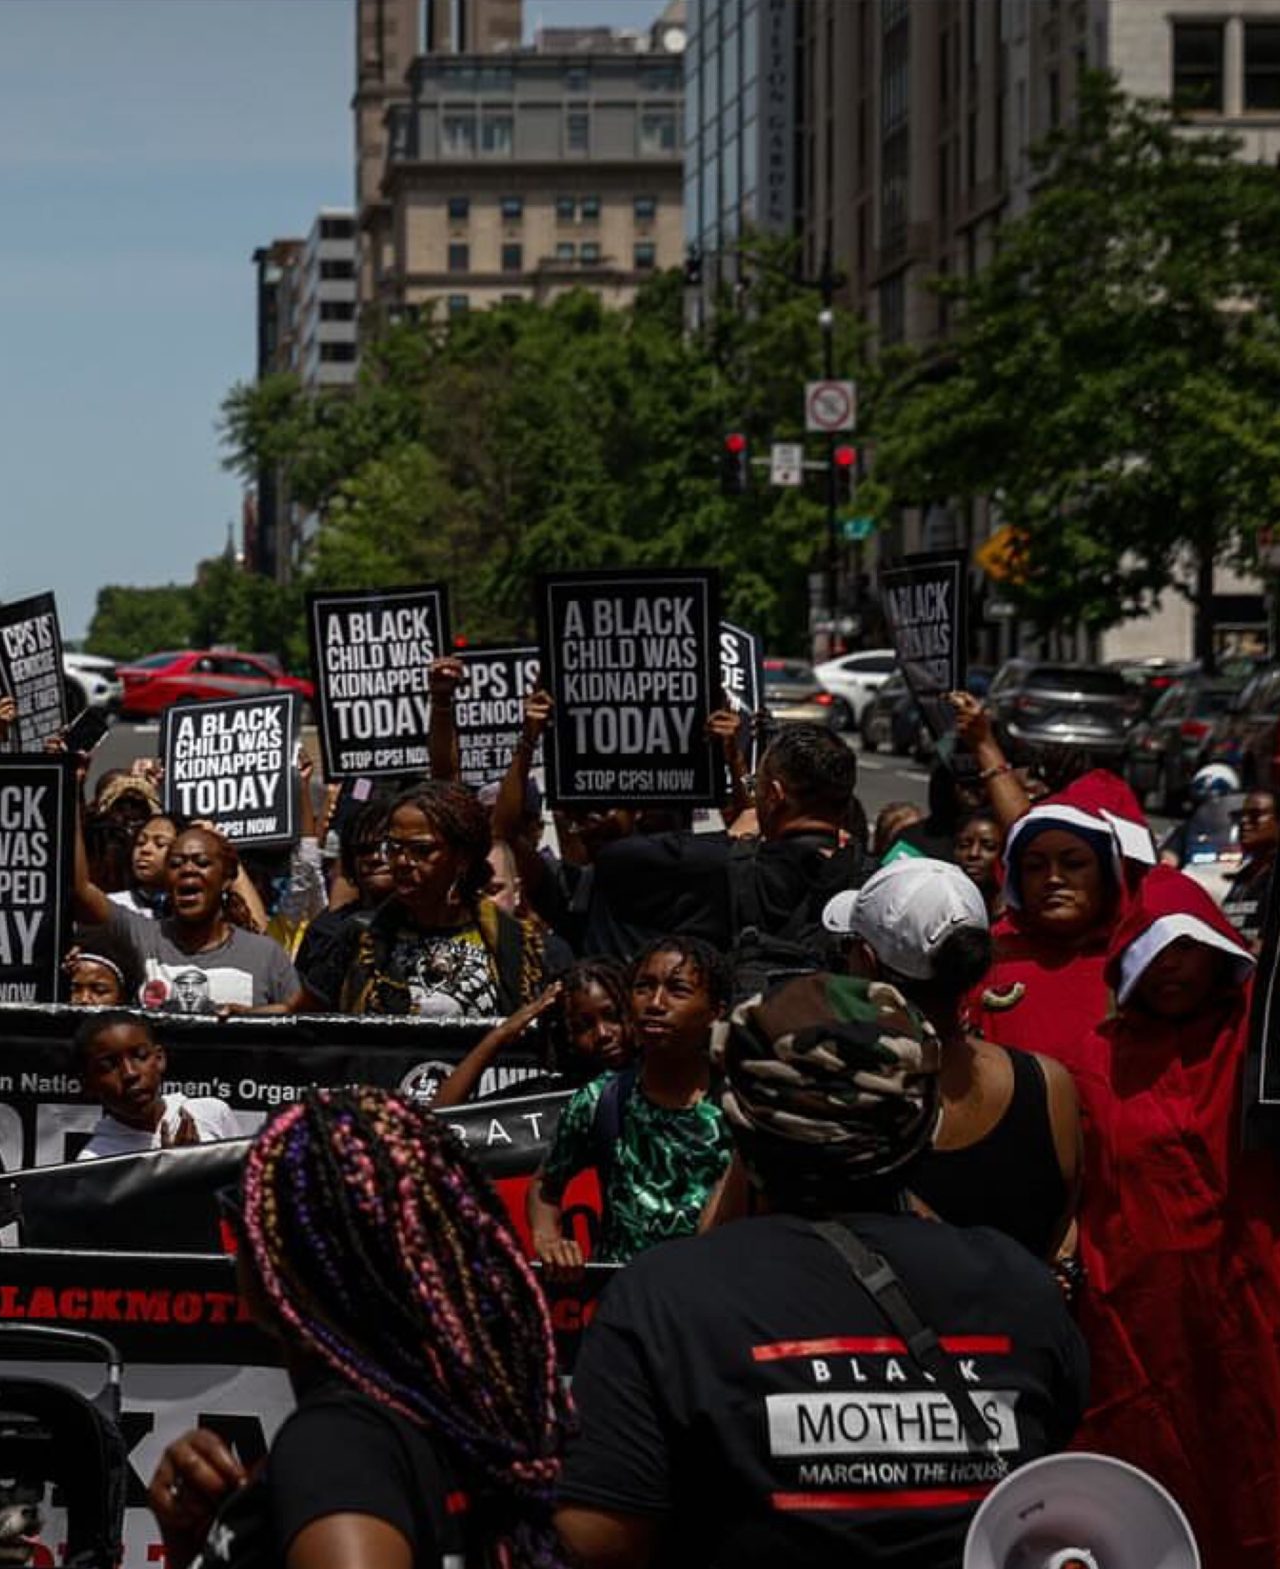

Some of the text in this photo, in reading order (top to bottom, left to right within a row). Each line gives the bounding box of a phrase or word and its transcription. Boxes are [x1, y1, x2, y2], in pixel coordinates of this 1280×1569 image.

[327, 607, 432, 645] A BLACK
[564, 597, 694, 637] A BLACK
[3, 614, 54, 660] CPS IS
[326, 640, 436, 672] CHILD WAS
[563, 636, 697, 672] CHILD WAS
[564, 671, 697, 703] KIDNAPPED
[177, 705, 283, 741] A BLACK
[332, 695, 432, 741] TODAY
[568, 706, 694, 755] TODAY
[176, 728, 283, 759] CHILD WAS
[340, 749, 372, 770] STOP
[374, 748, 407, 767] CPS!
[461, 750, 490, 769] ARE
[174, 748, 282, 780] KIDNAPPED
[574, 768, 694, 792] STOP CPS! NOW
[176, 772, 281, 816] TODAY
[246, 816, 278, 835] NOW
[161, 1077, 232, 1100] men's
[811, 1358, 982, 1384] BLAK
[798, 1463, 877, 1486] MARCH
[878, 1462, 909, 1484] ON
[910, 1461, 949, 1483] THE
